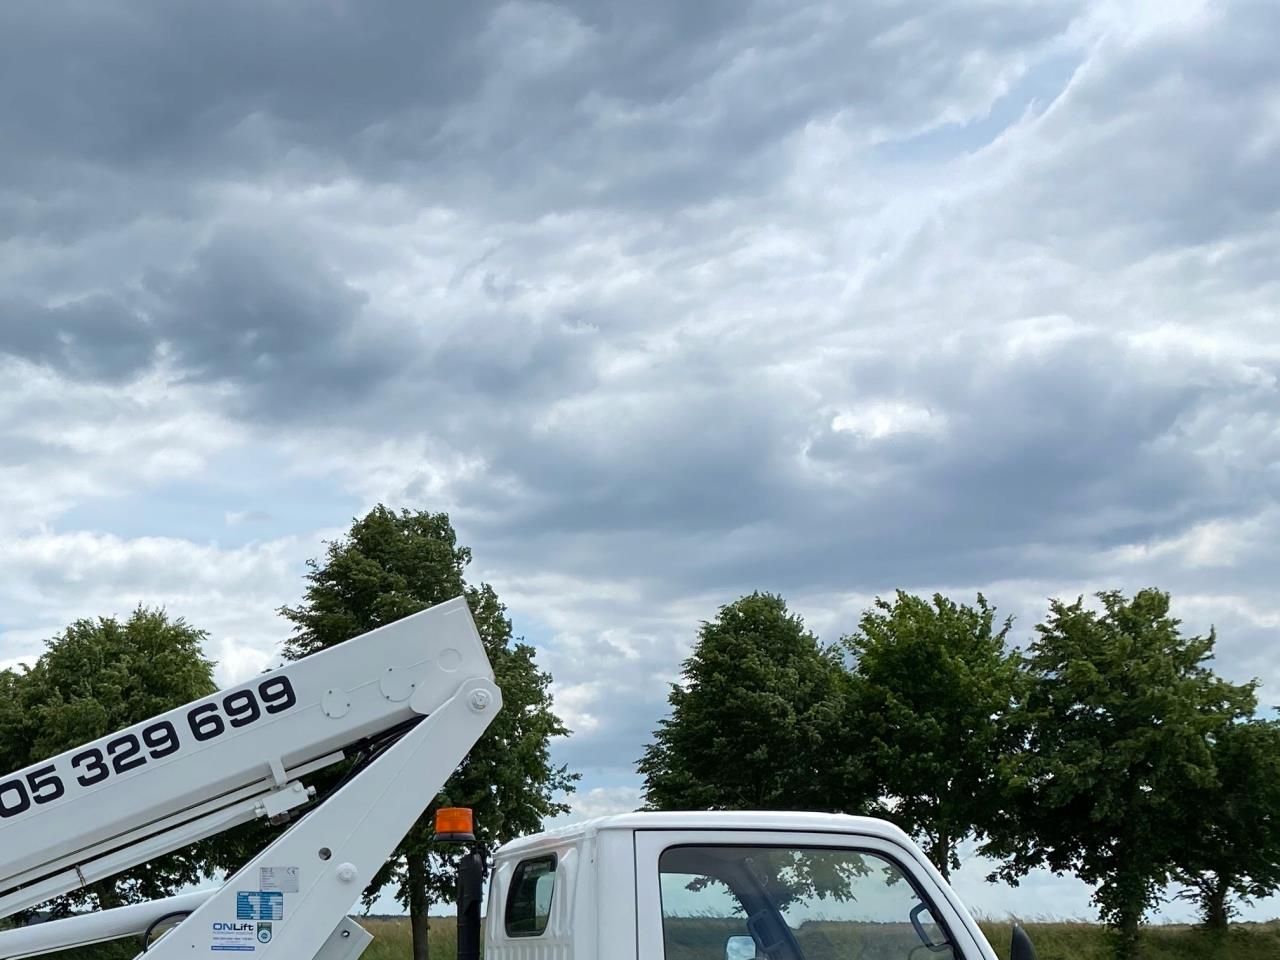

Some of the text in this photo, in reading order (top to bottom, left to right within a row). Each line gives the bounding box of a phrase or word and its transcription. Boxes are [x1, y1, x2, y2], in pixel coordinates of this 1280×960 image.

[71, 720, 180, 787] 329
[187, 675, 297, 742] 699
[212, 922, 254, 931] ONLift
